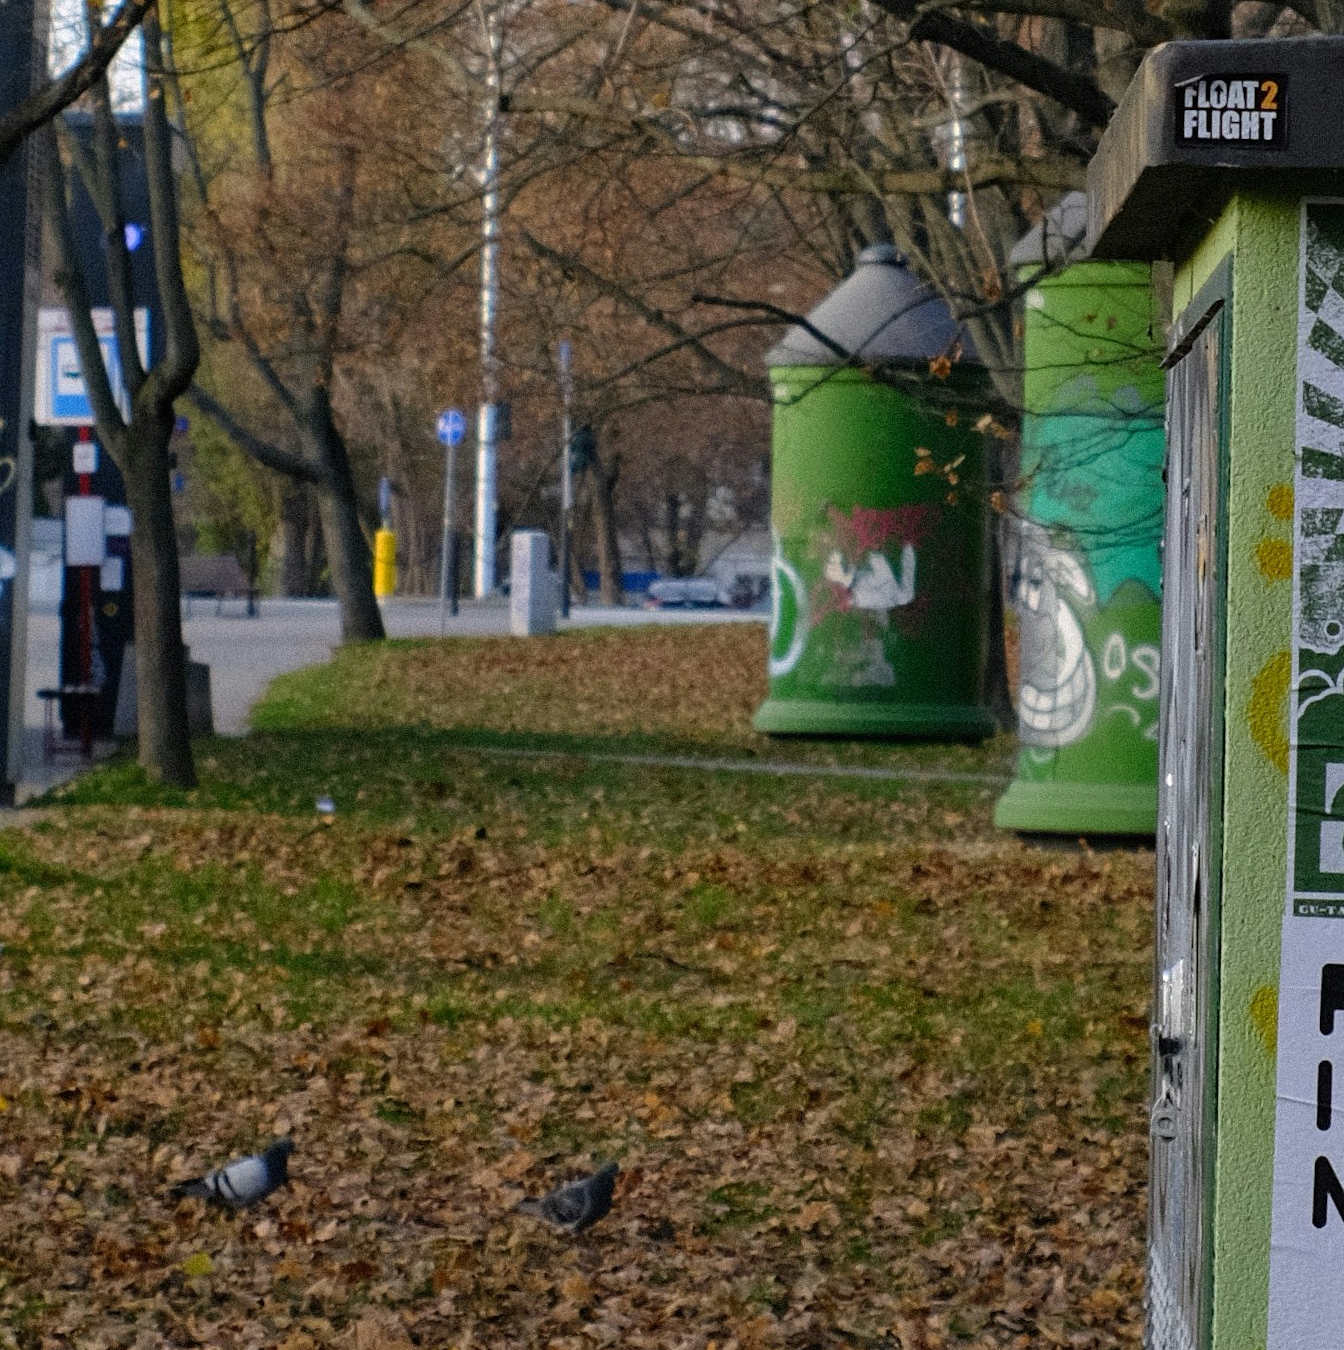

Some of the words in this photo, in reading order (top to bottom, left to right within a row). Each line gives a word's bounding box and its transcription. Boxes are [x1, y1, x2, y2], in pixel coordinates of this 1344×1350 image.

[1184, 79, 1259, 110] FLOAT
[1260, 80, 1279, 110] 2
[1183, 109, 1277, 141] FLIGHT
